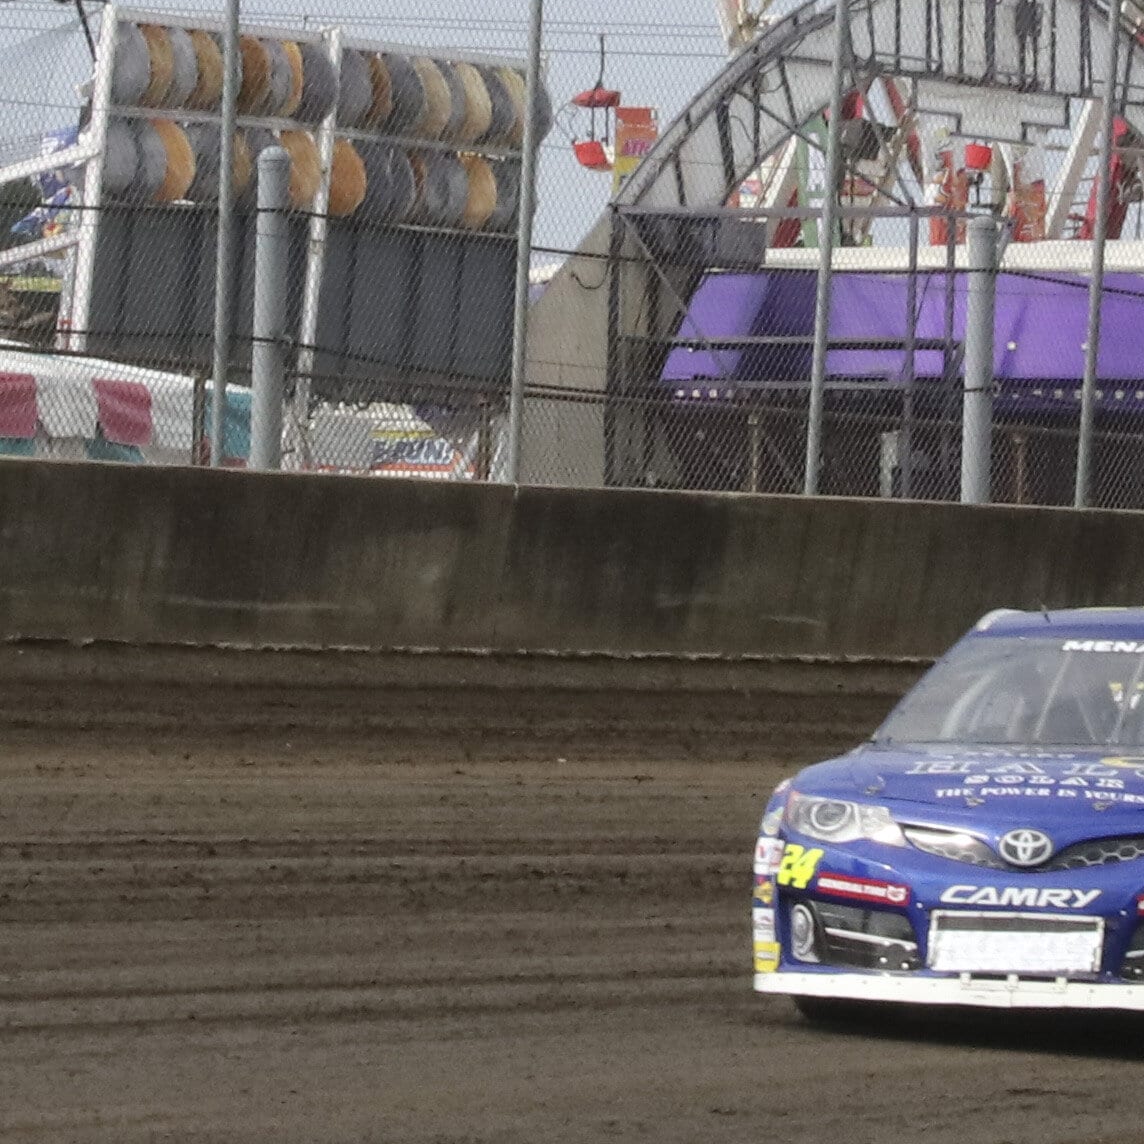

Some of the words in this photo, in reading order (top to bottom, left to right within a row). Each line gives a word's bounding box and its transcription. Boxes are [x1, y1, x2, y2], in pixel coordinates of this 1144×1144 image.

[963, 775, 1125, 790] SOLAR
[934, 787, 976, 799] THE
[981, 787, 1051, 798] POWER
[1057, 788, 1077, 799] IS
[777, 844, 825, 889] 24
[817, 877, 863, 893] GENERAL
[864, 885, 888, 897] TIRE
[939, 884, 1104, 909] CAMRY
